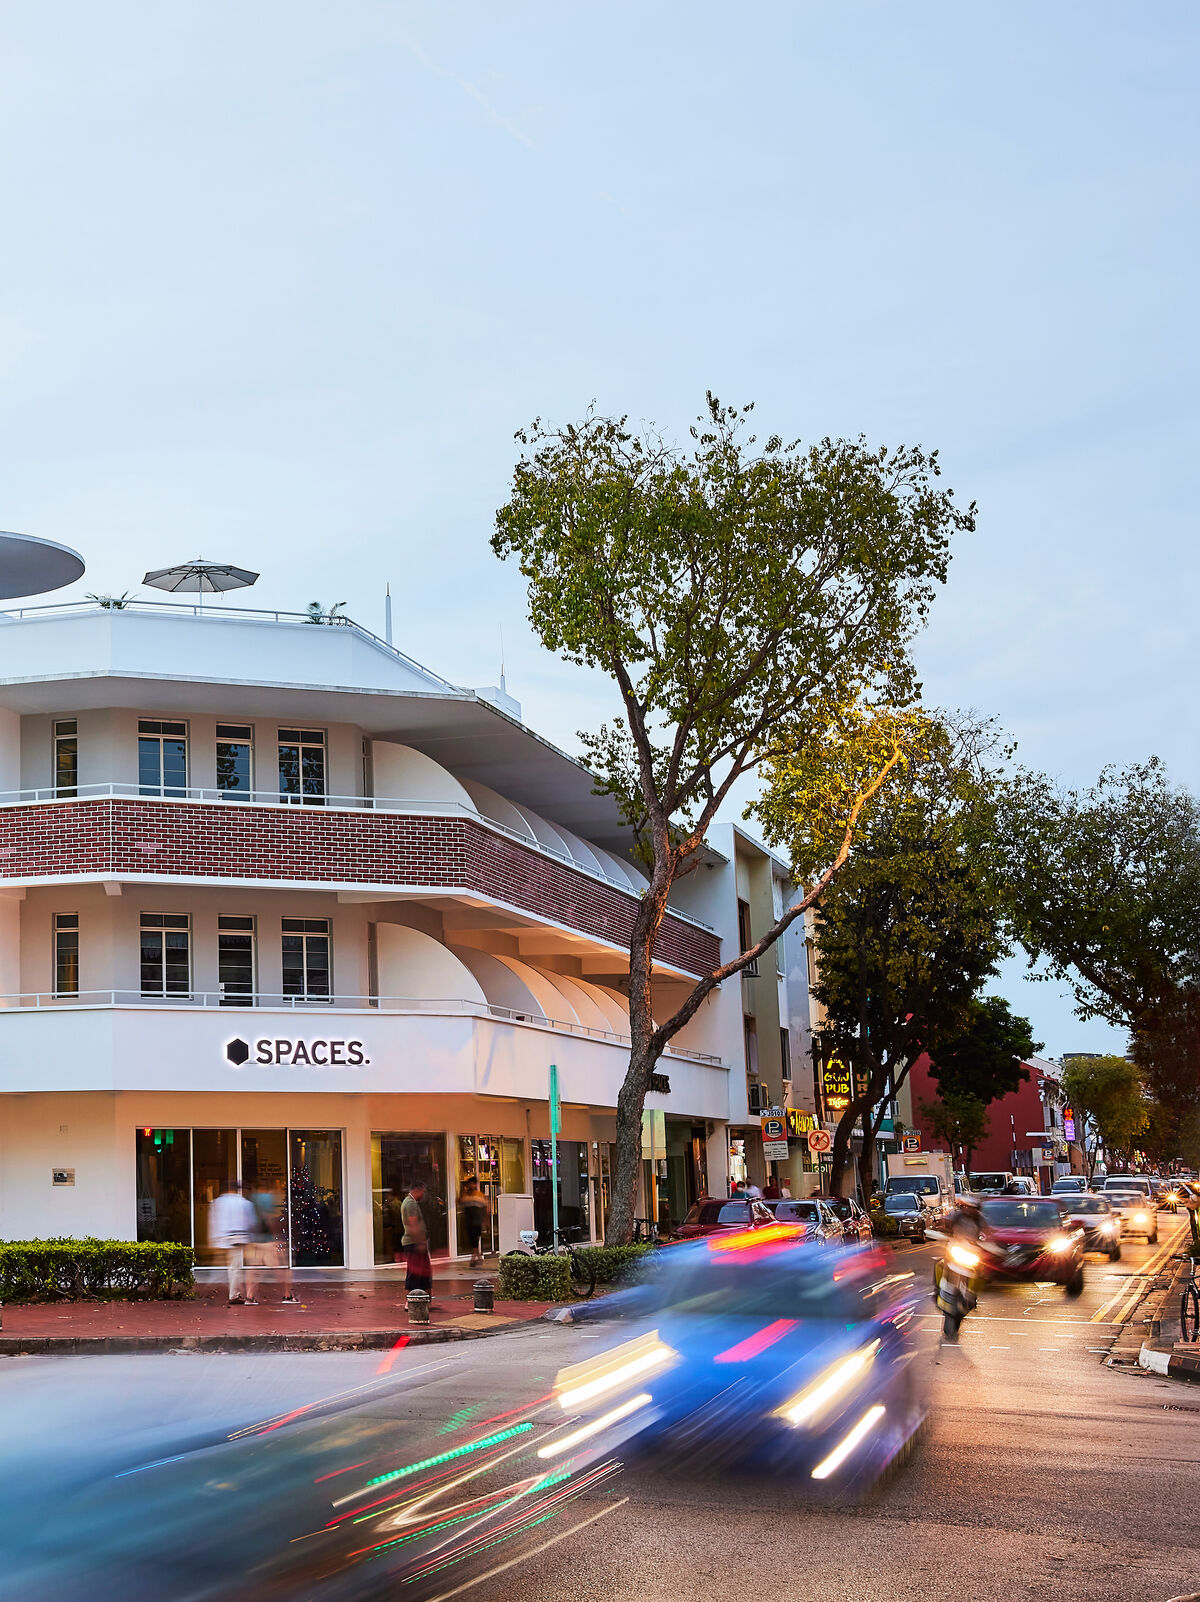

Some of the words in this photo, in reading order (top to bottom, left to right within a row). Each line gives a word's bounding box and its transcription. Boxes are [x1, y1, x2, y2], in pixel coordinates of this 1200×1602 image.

[256, 1039, 371, 1065] SPACES.
[825, 1083, 850, 1094] PUB
[827, 1097, 849, 1109] Tiger
